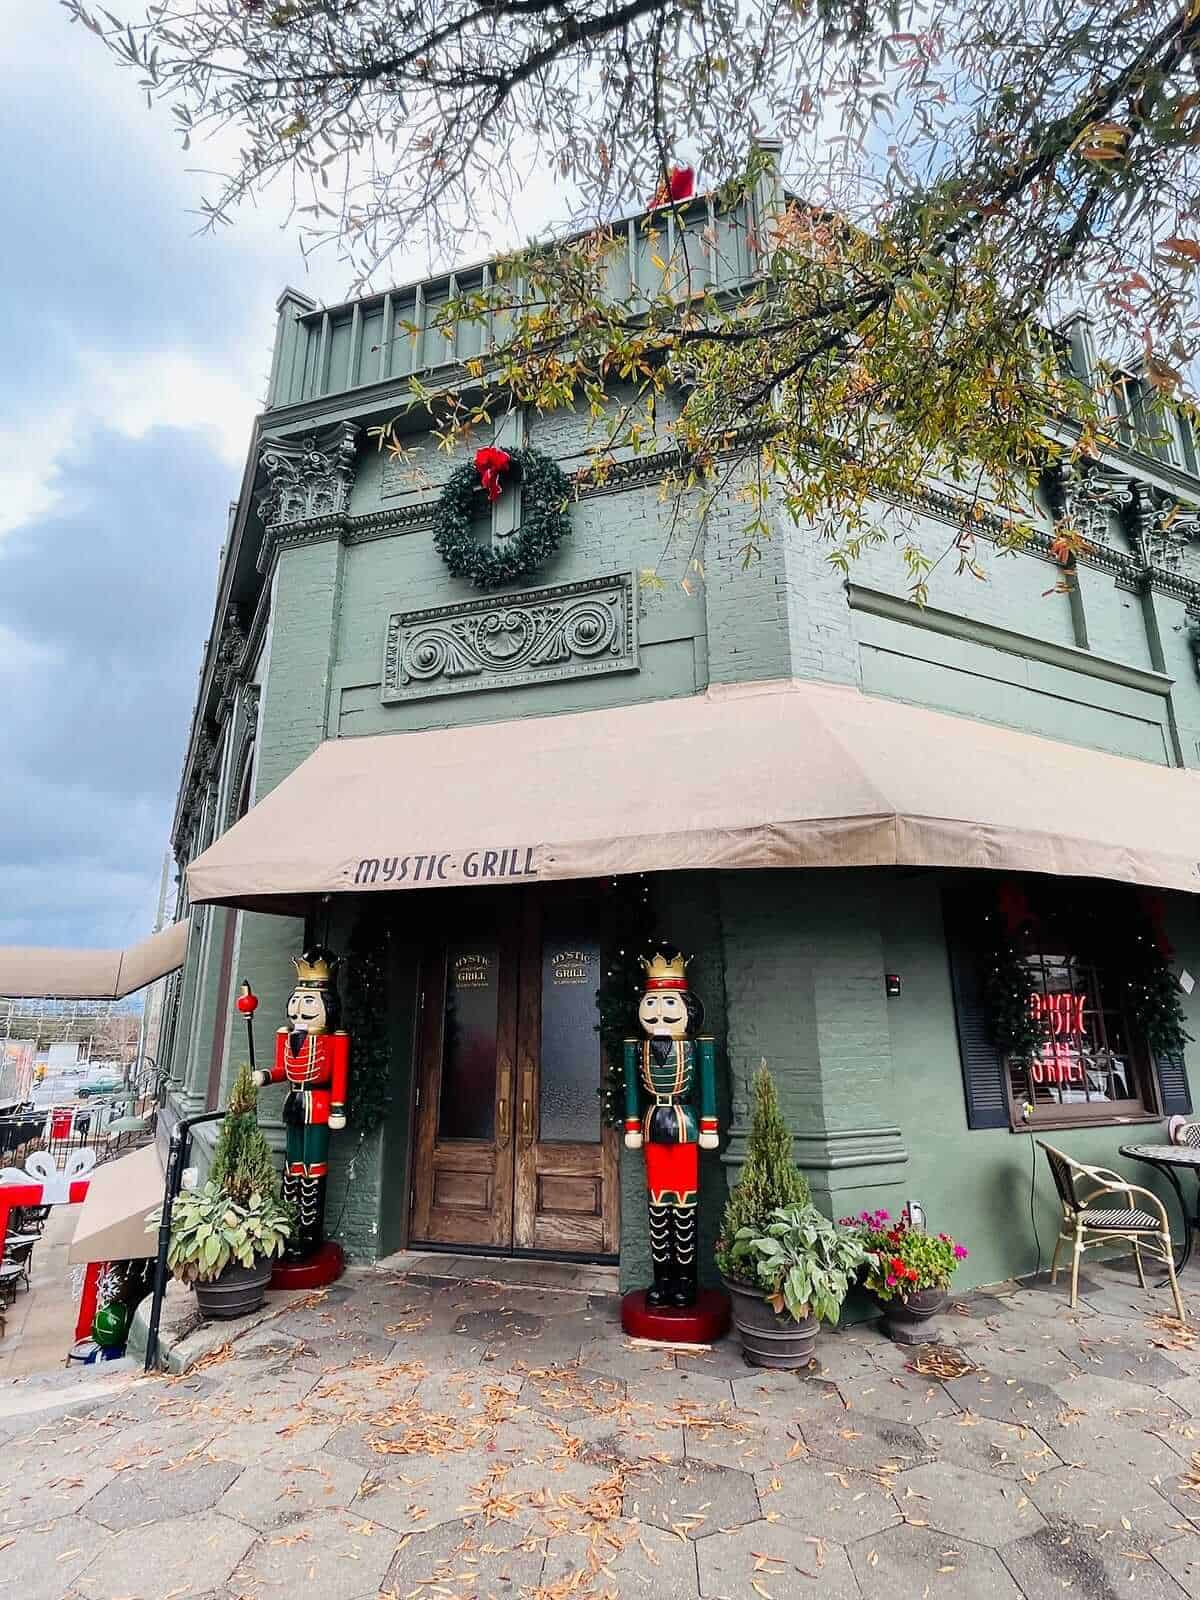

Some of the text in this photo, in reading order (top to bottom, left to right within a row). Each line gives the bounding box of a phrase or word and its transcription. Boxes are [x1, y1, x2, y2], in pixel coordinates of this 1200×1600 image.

[463, 847, 538, 878] GRILL
[457, 971, 486, 981] GRILL
[555, 968, 586, 978] GRILL
